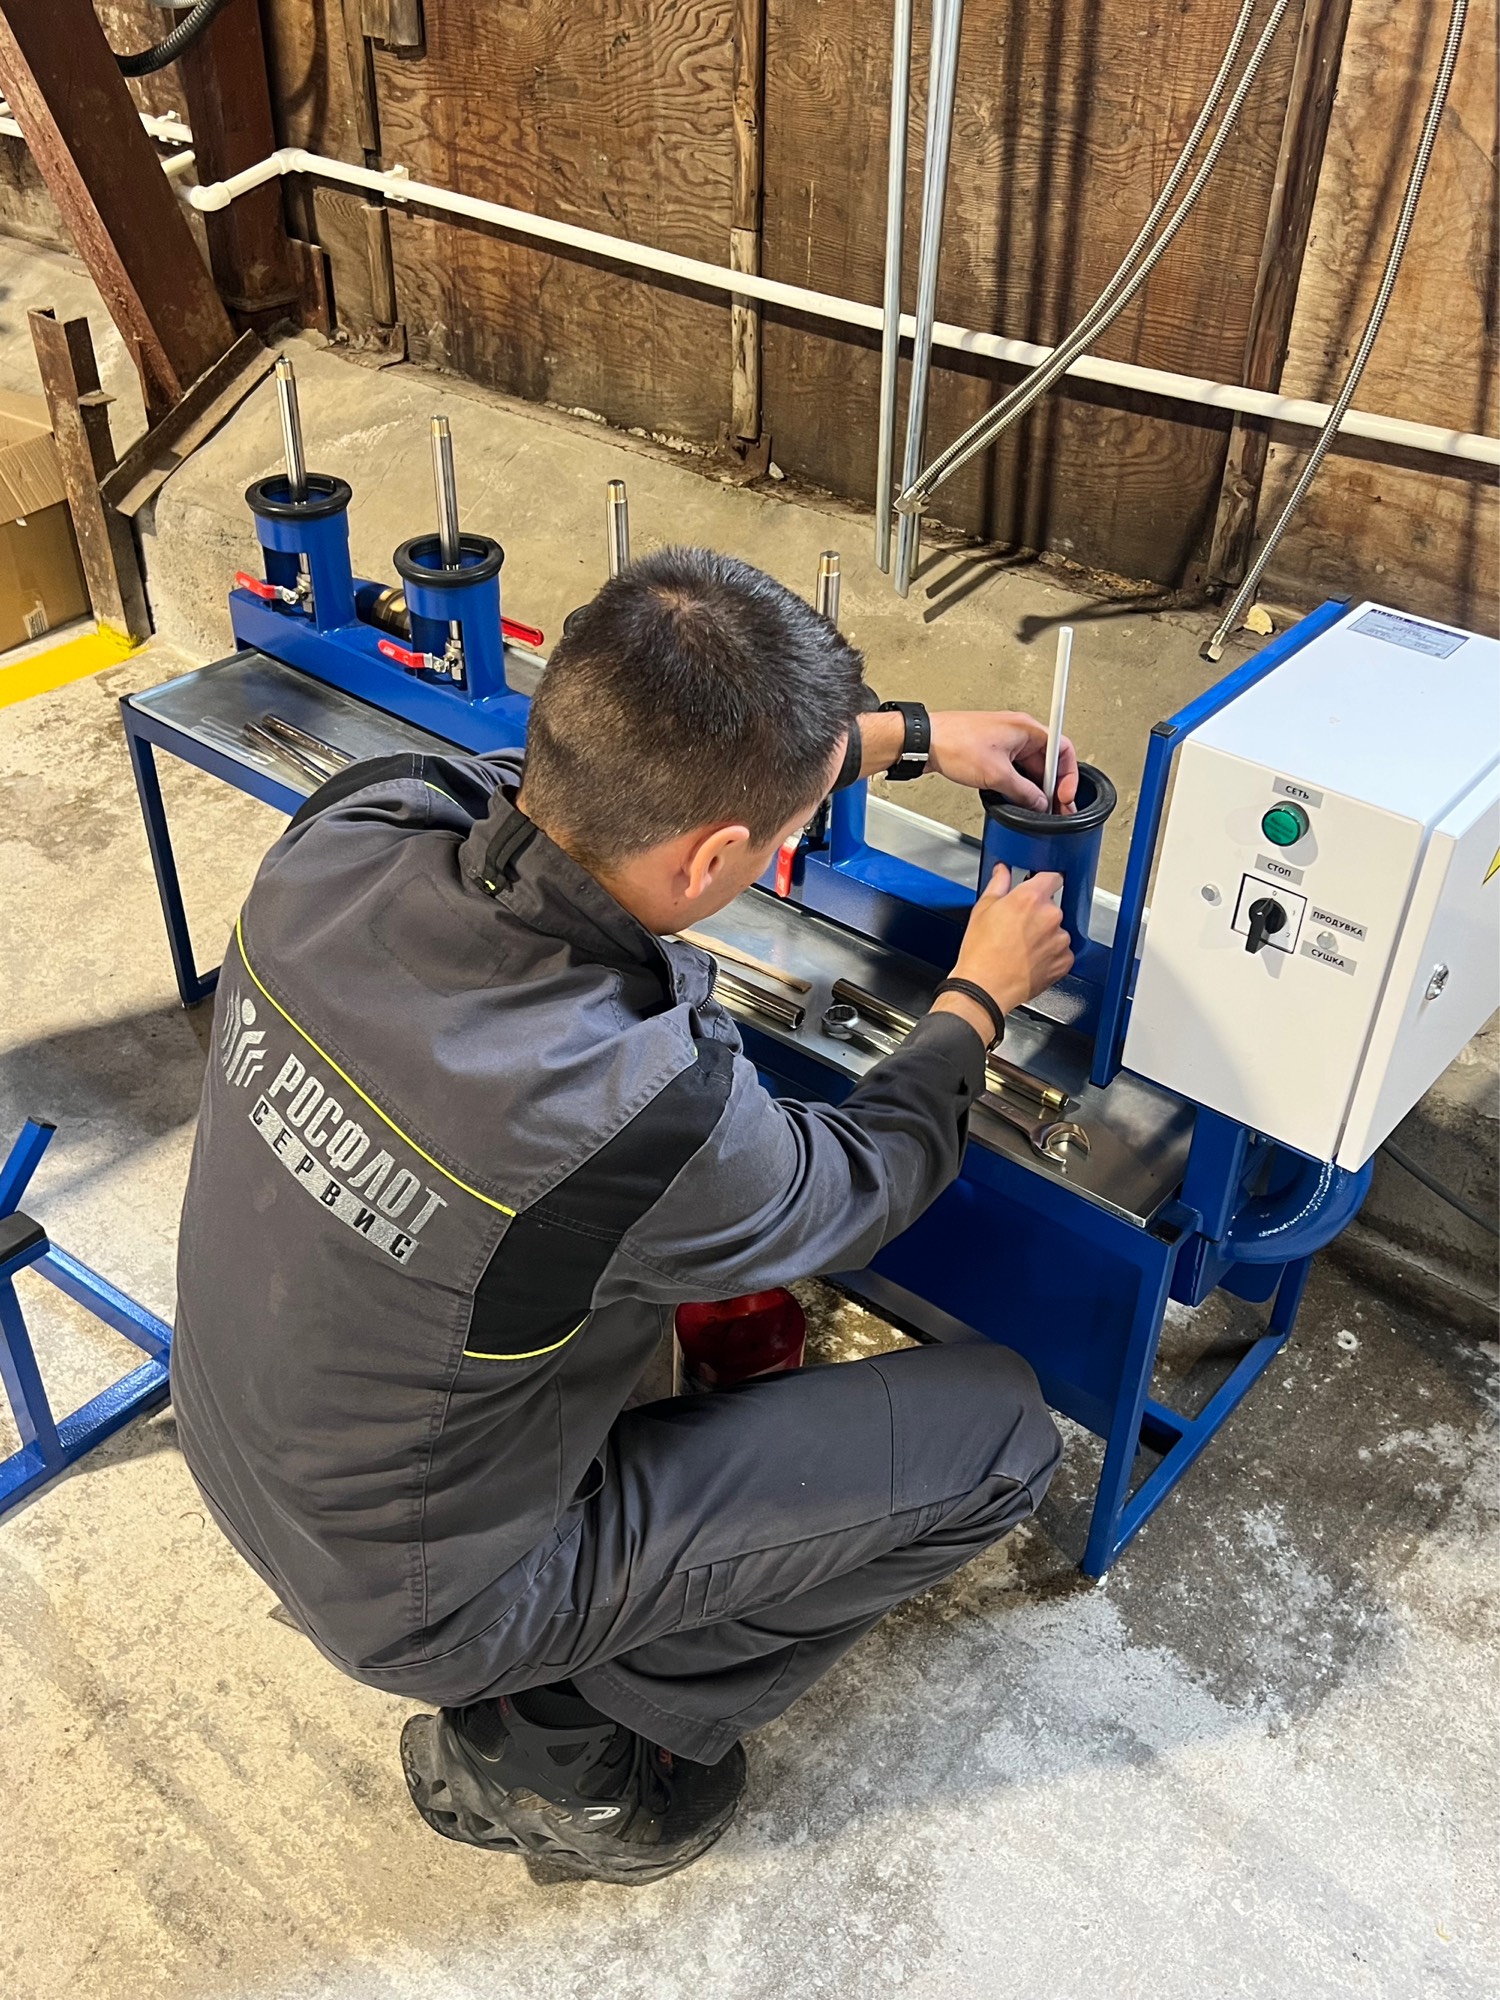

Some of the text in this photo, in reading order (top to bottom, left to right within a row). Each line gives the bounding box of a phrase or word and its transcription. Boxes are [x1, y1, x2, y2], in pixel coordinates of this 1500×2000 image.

[1285, 785, 1310, 800] СЕТЬ
[1267, 862, 1292, 877] СТОП
[1312, 911, 1364, 937] ПРОДУВКА
[1311, 948, 1345, 968] СУШКА
[267, 1053, 449, 1235] РОСФЛОТ
[251, 1101, 413, 1259] СЕРВИС
